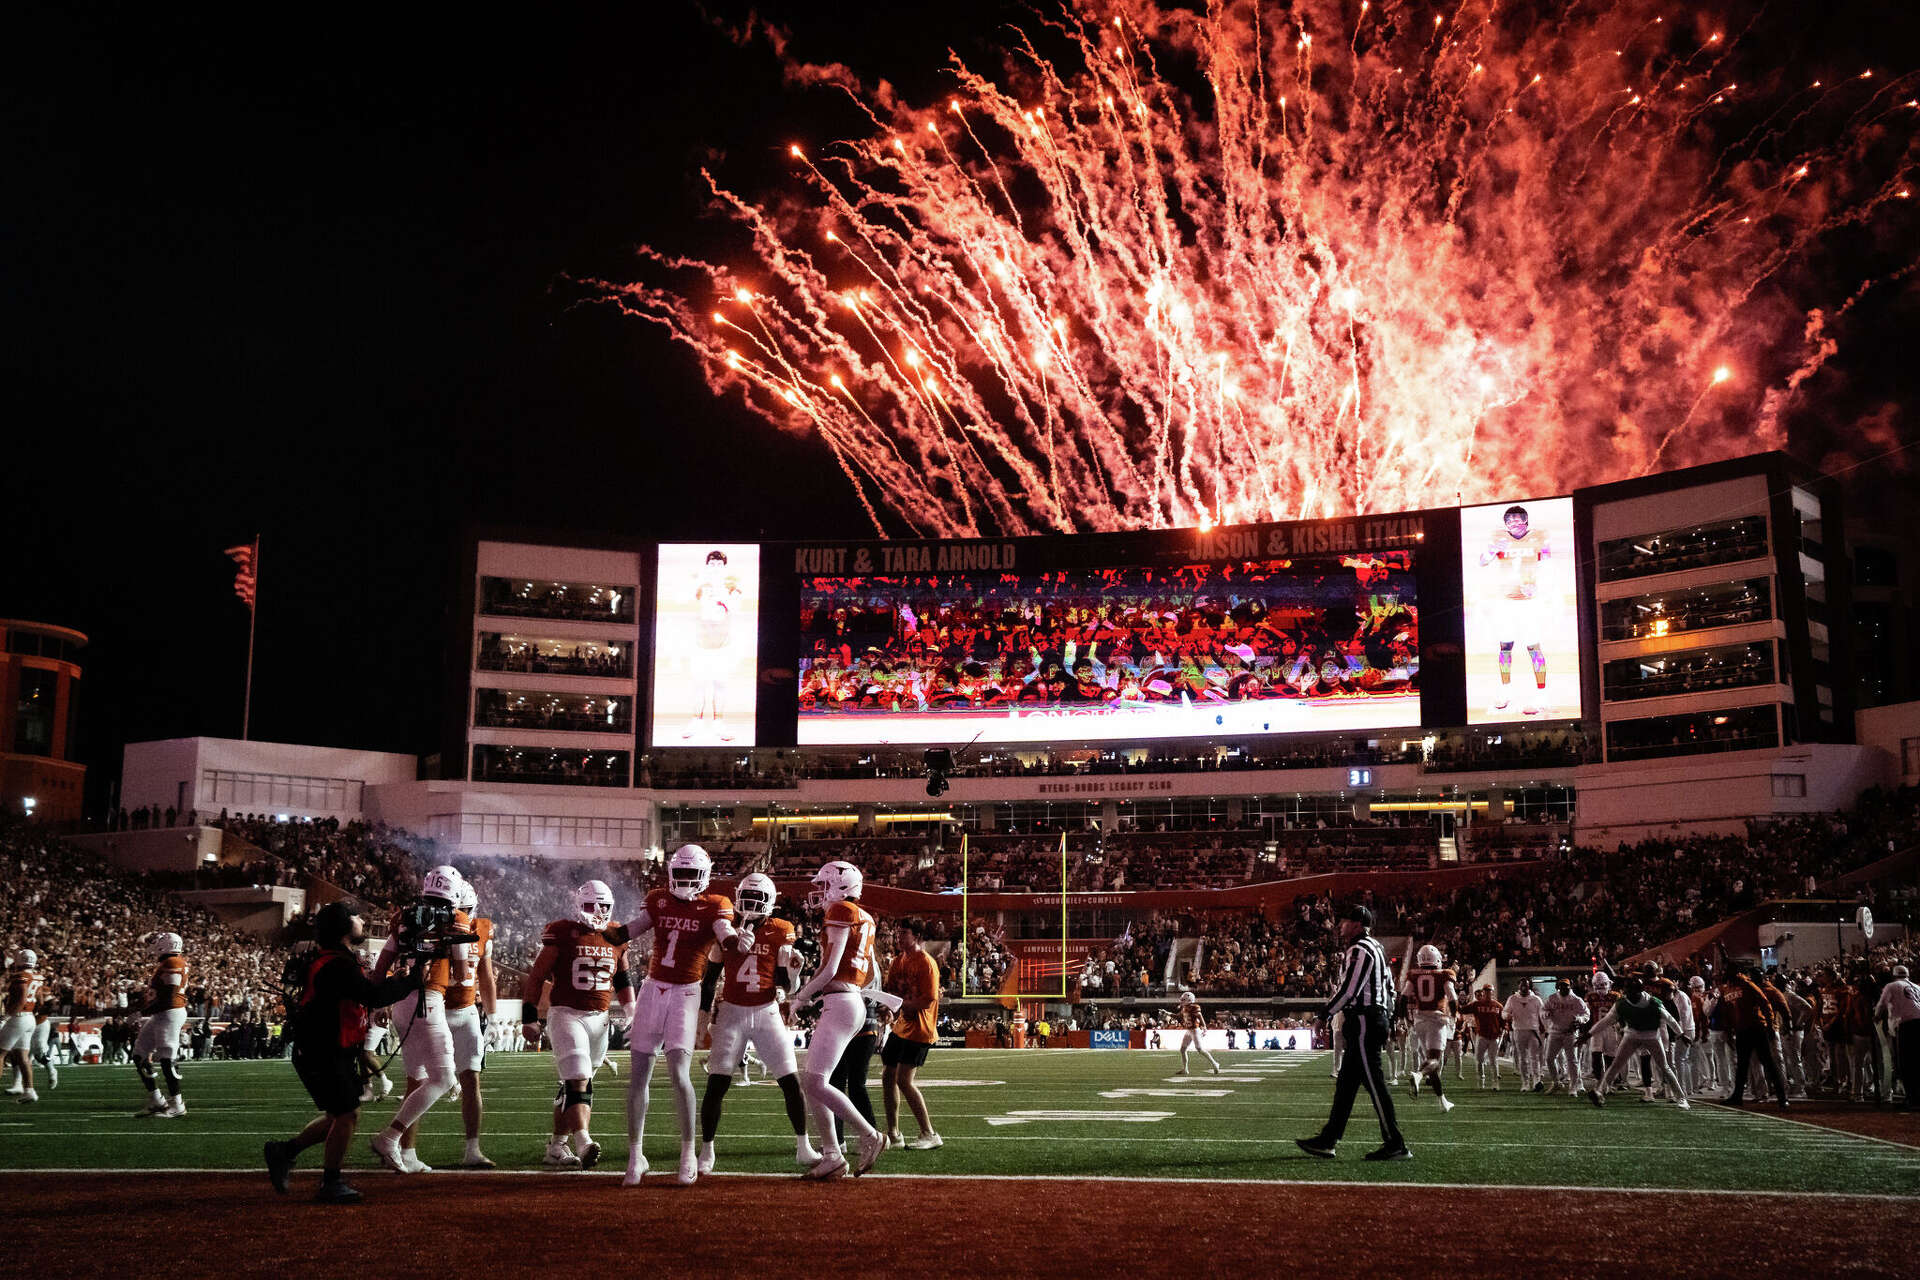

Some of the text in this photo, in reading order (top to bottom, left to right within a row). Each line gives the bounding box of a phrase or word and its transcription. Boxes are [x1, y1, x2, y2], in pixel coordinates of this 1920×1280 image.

[1188, 517, 1425, 560] JASON & KISHA ITKIN
[795, 543, 1017, 573] KURT & TARA ARNOLD
[1350, 770, 1370, 785] 31
[430, 875, 443, 889] 16
[658, 916, 700, 932] TEXAS
[576, 945, 614, 957] TEXAS
[660, 929, 680, 969] 1
[571, 956, 616, 991] 62
[736, 954, 761, 992] 4
[1417, 974, 1435, 1002] 0
[1094, 1031, 1126, 1042] DELL
